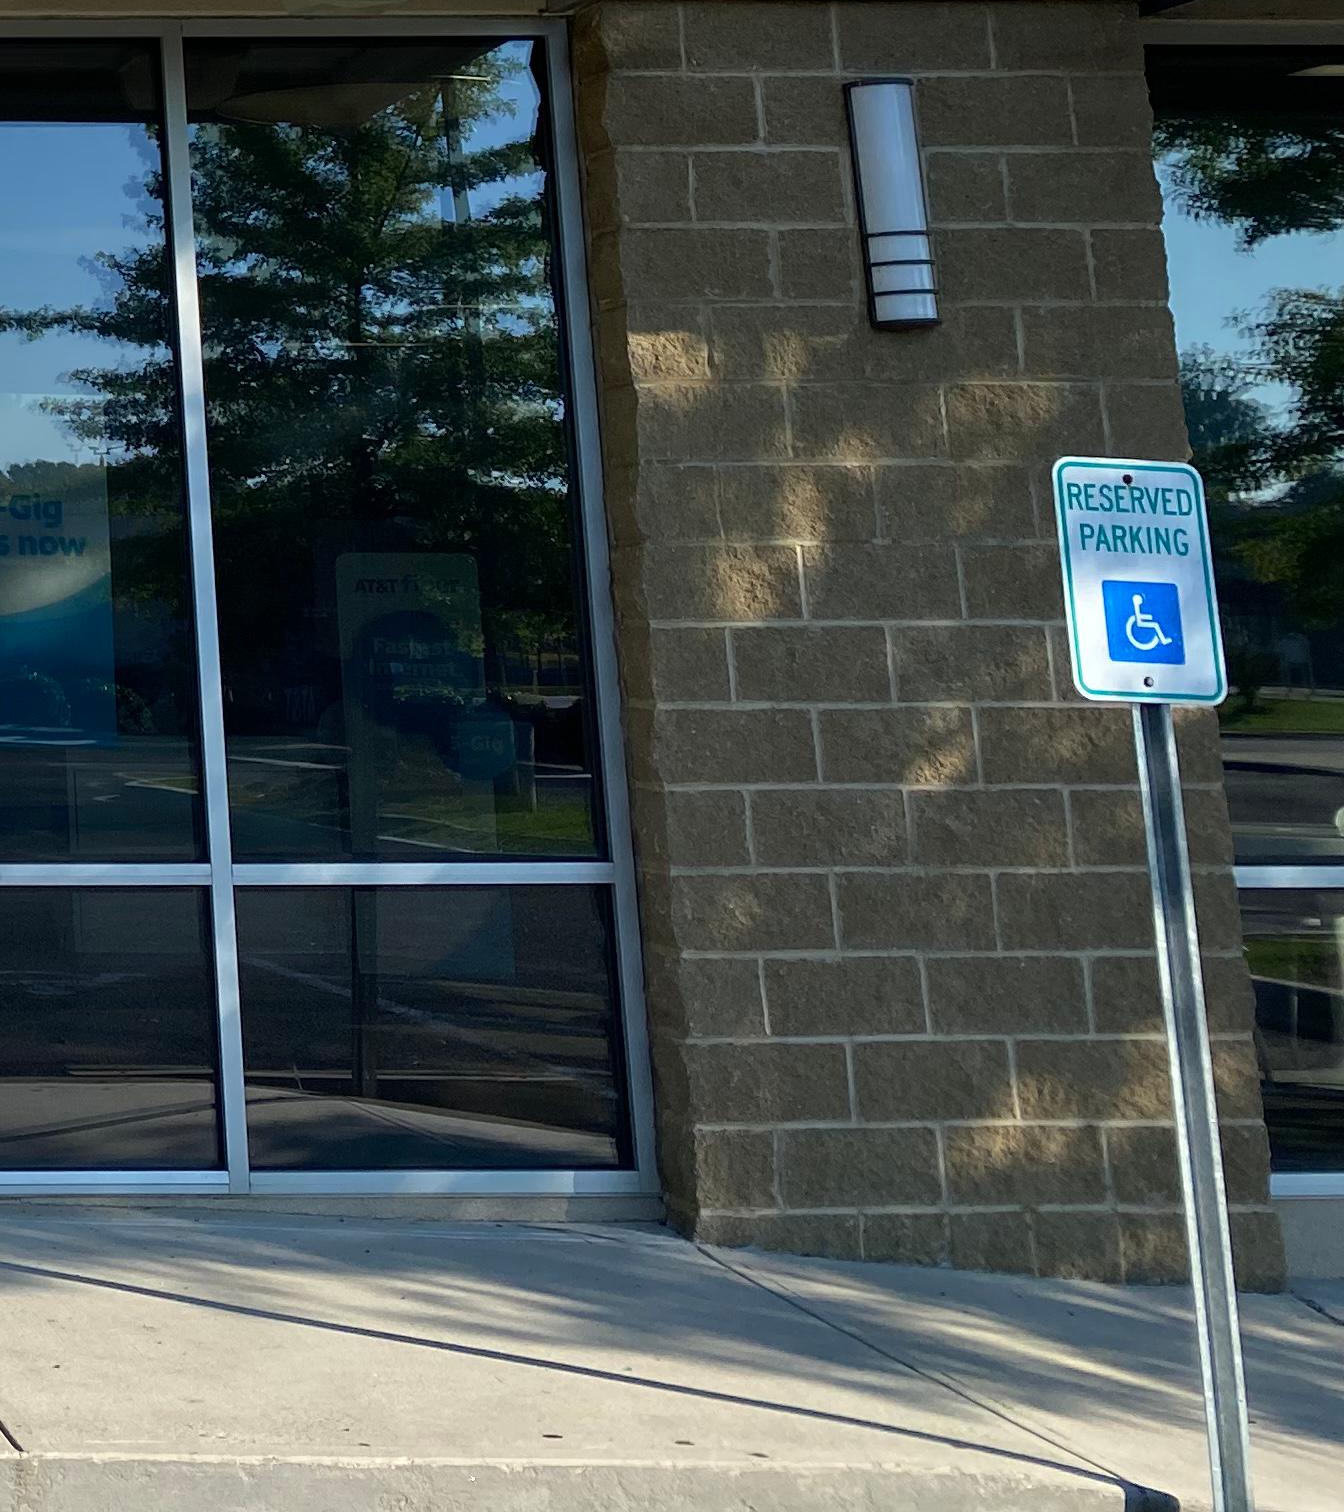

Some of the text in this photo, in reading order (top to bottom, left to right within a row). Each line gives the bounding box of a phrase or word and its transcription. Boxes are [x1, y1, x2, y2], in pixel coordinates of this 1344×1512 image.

[1066, 482, 1193, 517] RESERVED
[17, 535, 88, 557] now
[1079, 523, 1189, 557] PARKING
